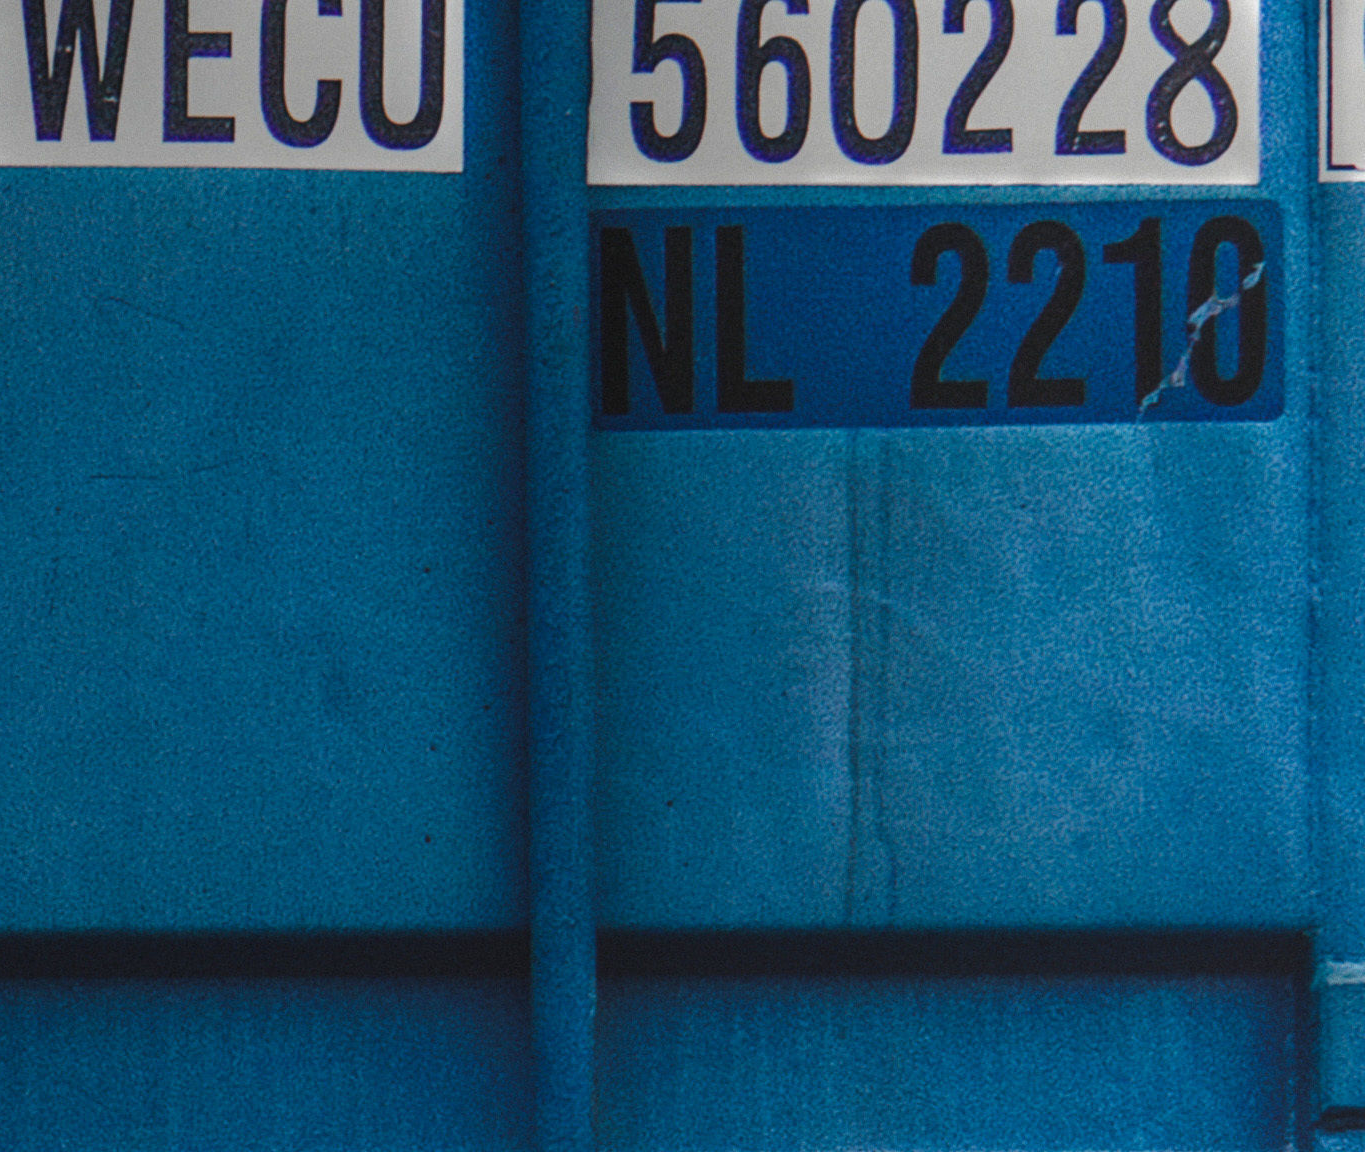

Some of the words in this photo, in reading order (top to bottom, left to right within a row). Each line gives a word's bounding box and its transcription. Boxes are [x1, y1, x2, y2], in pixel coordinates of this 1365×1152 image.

[21, 0, 446, 151] WECU
[630, 0, 1238, 166] 560228
[599, 224, 794, 415] NL
[910, 216, 1266, 410] 2210
